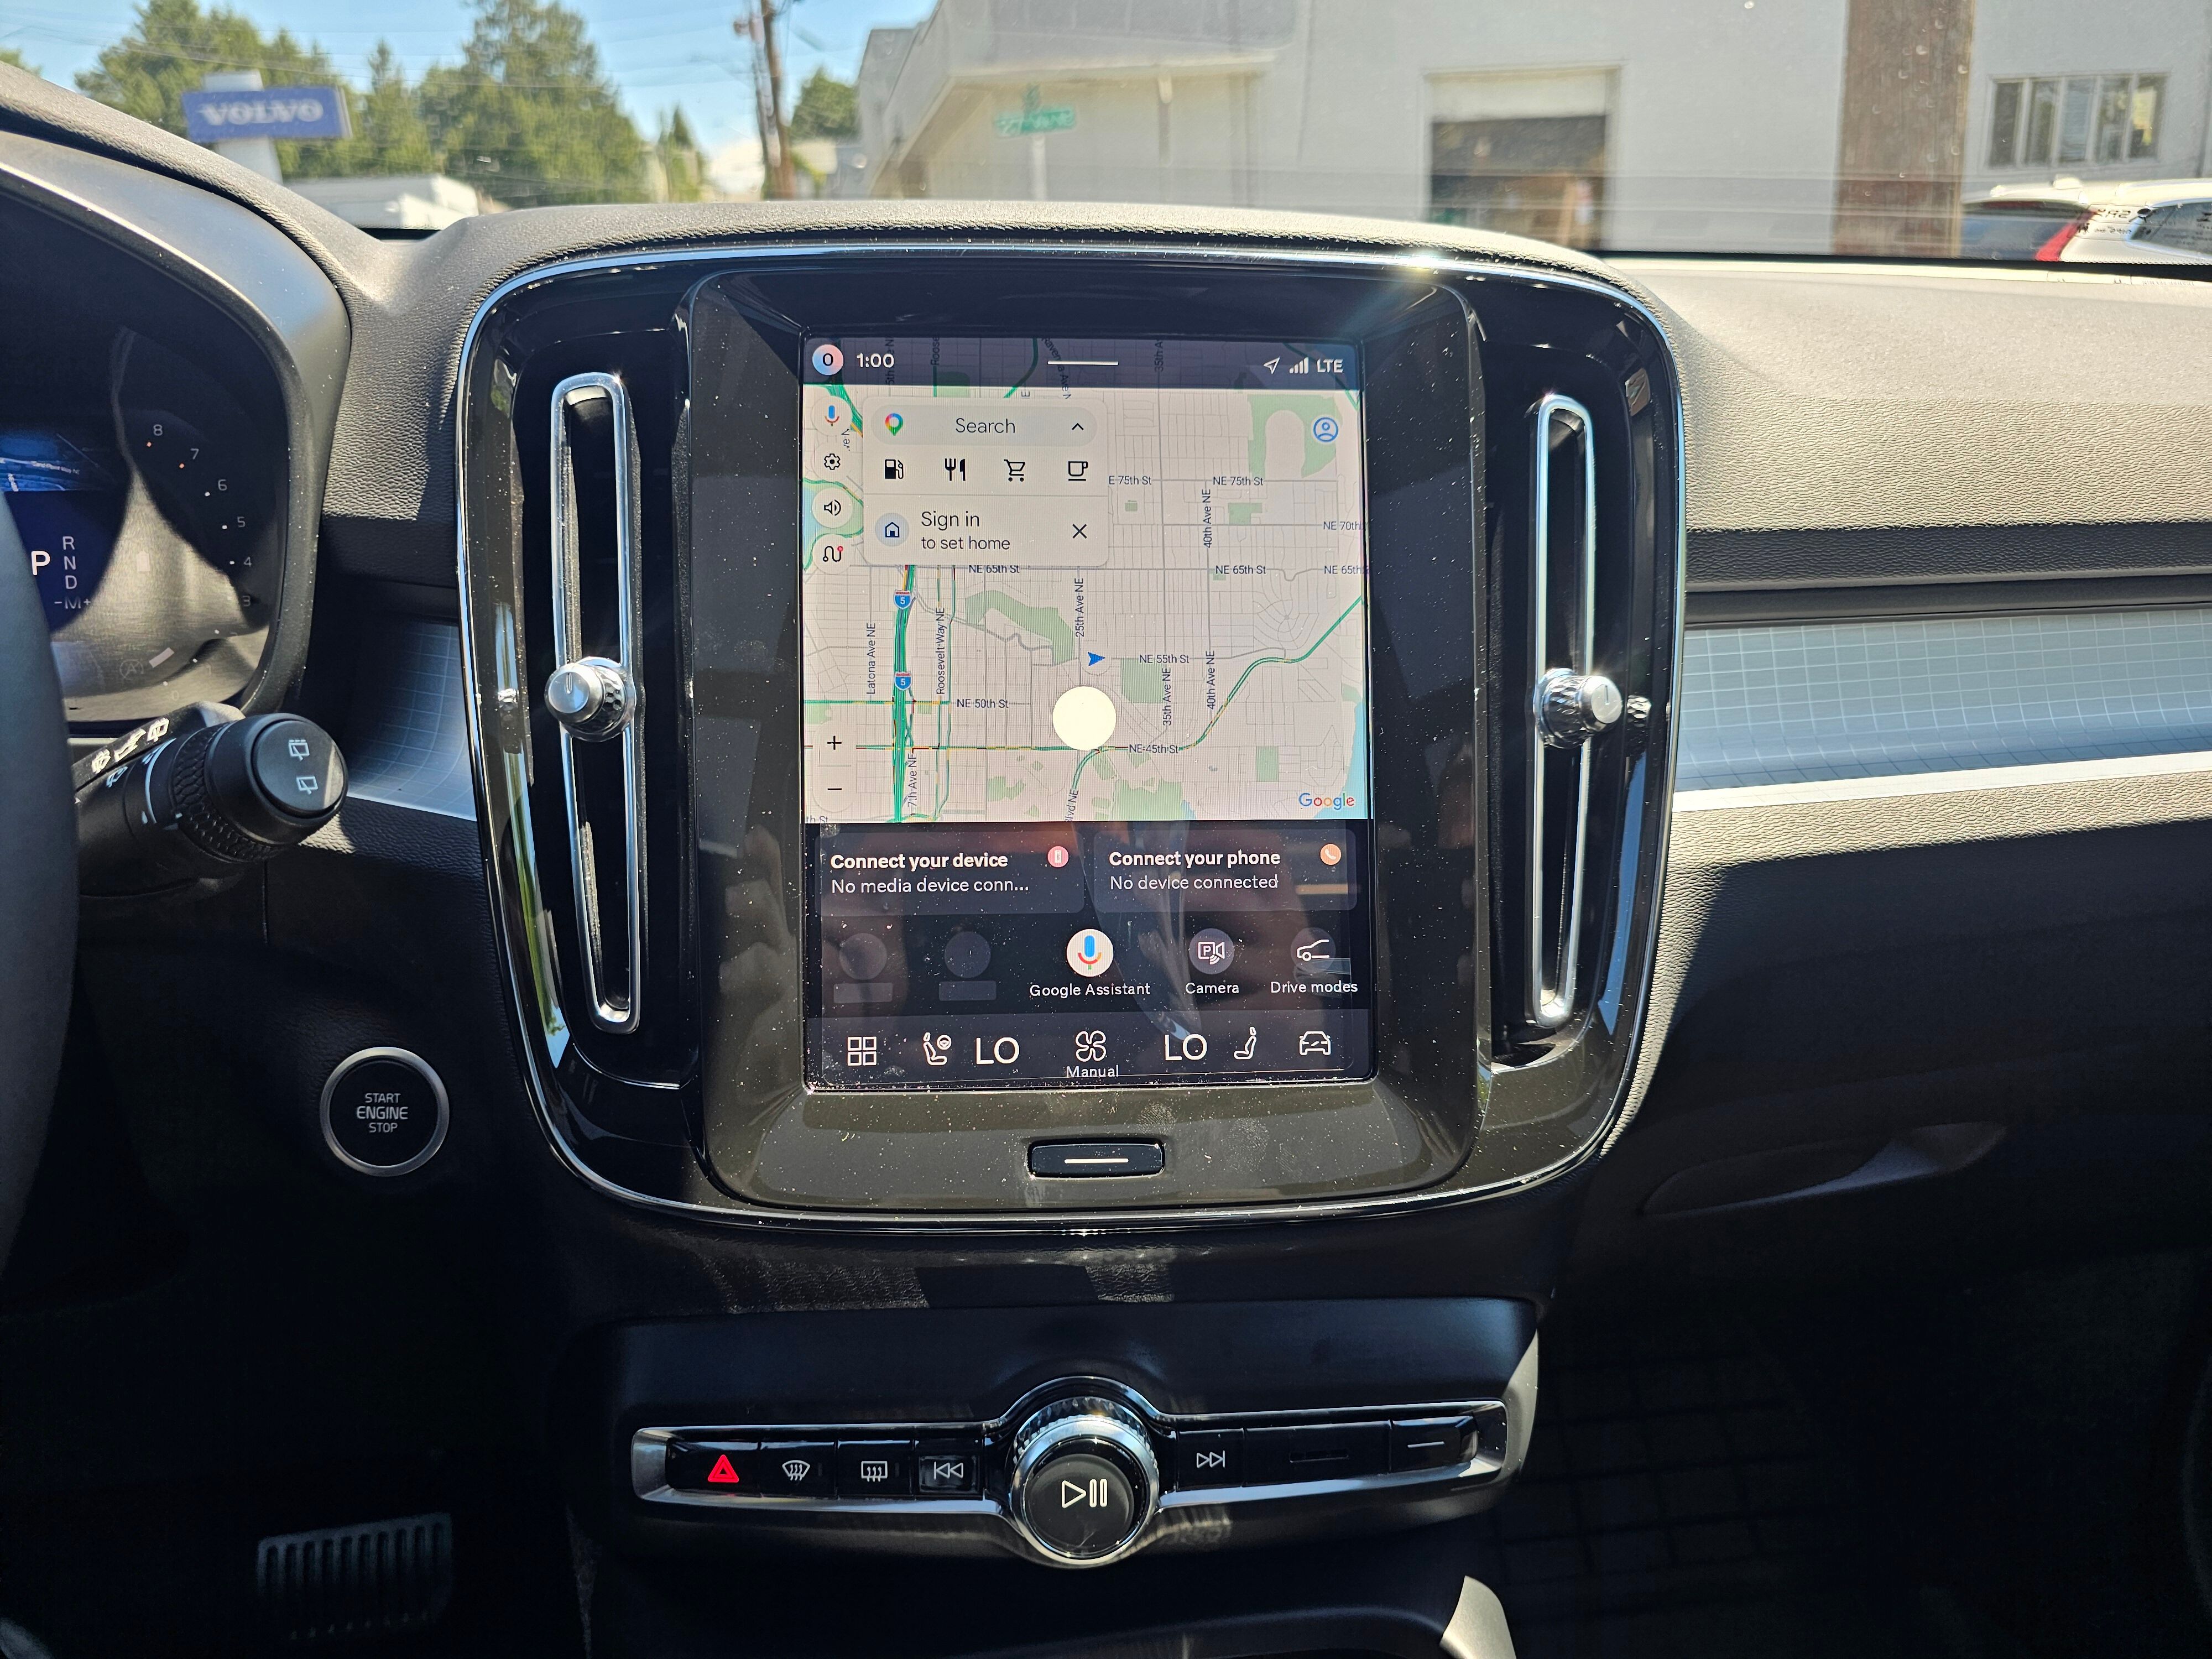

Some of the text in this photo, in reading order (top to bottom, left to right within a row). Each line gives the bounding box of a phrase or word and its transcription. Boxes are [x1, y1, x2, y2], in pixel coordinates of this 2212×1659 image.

[200, 98, 324, 126] VOLVO
[857, 352, 895, 368] 1:00
[1317, 358, 1344, 373] LTE
[153, 424, 163, 436] 8
[955, 417, 1016, 434] Search
[190, 448, 199, 460] 7
[218, 479, 227, 491] 6
[1118, 476, 1139, 486] 75th
[1141, 476, 1152, 486] St
[1213, 477, 1264, 486] NE 75th St
[237, 517, 246, 528] 5
[921, 510, 979, 531] Sign in
[1202, 489, 1212, 548] 40th Ave NE
[1323, 521, 1360, 530] NE 70th
[62, 536, 75, 550] R
[921, 536, 1010, 550] to set home
[31, 550, 50, 576] P
[64, 556, 76, 570] N
[243, 557, 252, 567] 4
[1215, 566, 1266, 575] NE 65th St
[1324, 566, 1361, 574] NE 65th
[65, 575, 77, 589] D
[242, 596, 251, 607] 3
[1074, 578, 1085, 638] 25th Ave NE
[936, 608, 947, 694] Roosevelt Way NE
[867, 623, 875, 695] Latona Ave NE
[1139, 655, 1189, 664] NE 55th St
[1206, 650, 1215, 709] 40th Ave NE
[957, 699, 1008, 708] NE 50th St
[1162, 668, 1171, 726] 35th Ave NE
[1129, 745, 1178, 754] NE 45th St
[908, 753, 916, 807] 7th Ave NE
[1068, 789, 1078, 803] NE
[1298, 792, 1355, 810] Google
[831, 852, 1009, 871] Connect your device
[1109, 850, 1281, 869] Connect your phone
[832, 878, 1029, 893] No media device conn...
[1110, 875, 1279, 890] No device connected
[1029, 983, 1151, 998] Google Assistant
[1186, 982, 1240, 994] Camera
[1271, 980, 1358, 993] Drive modes
[975, 1037, 1020, 1065] LO
[1165, 1034, 1207, 1061] LO
[1066, 1065, 1119, 1078] Manual
[364, 1093, 401, 1103] START
[356, 1105, 409, 1120] ENGINE
[369, 1122, 398, 1133] STOP
